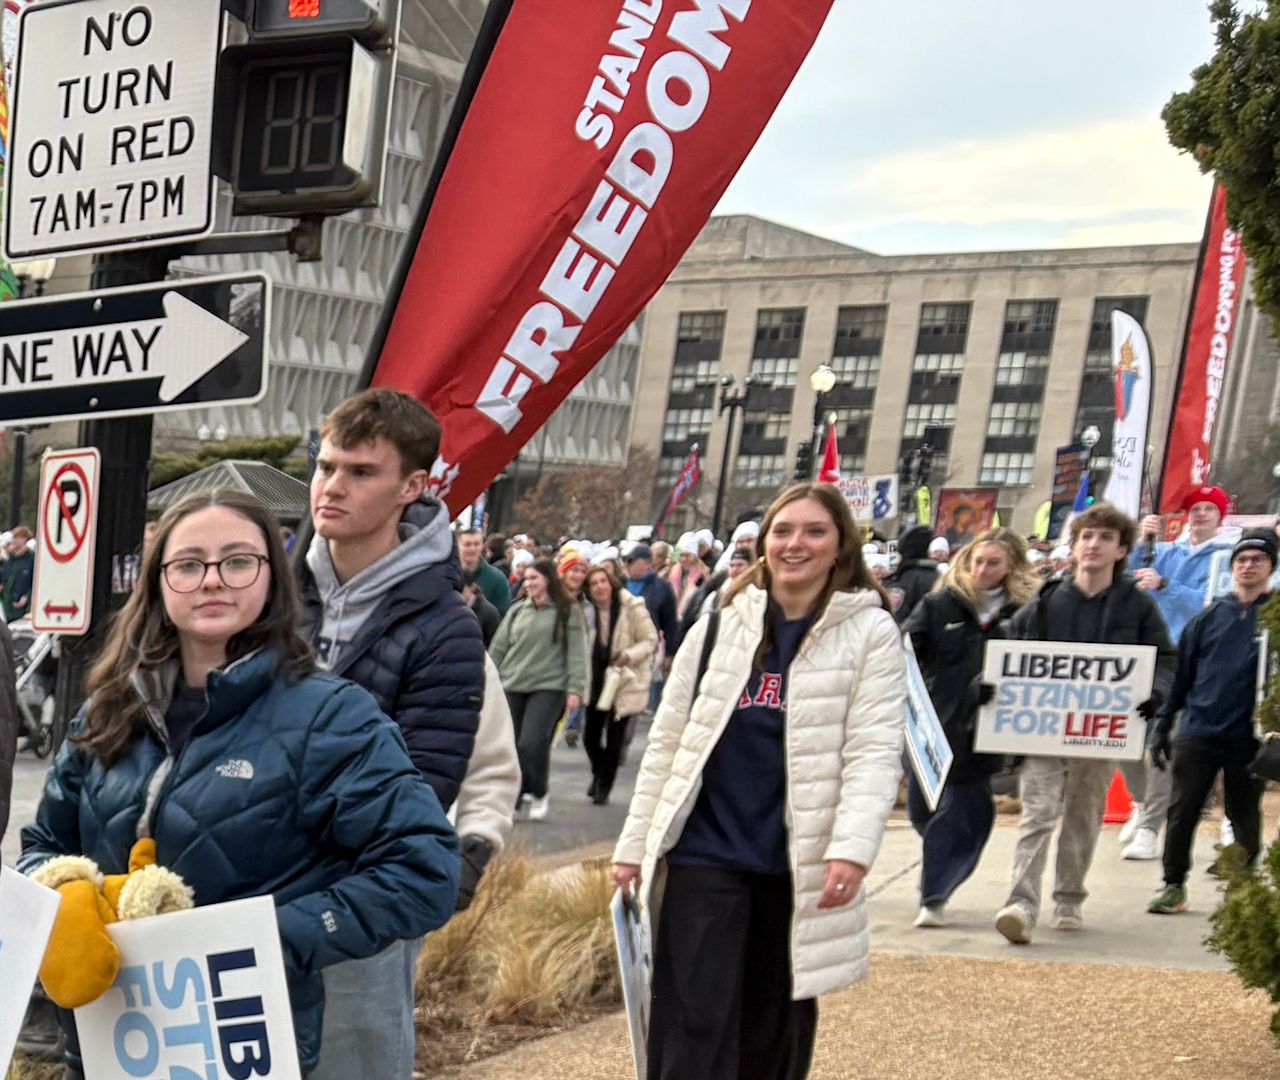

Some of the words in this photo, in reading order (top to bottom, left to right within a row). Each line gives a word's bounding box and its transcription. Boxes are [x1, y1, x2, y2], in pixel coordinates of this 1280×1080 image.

[83, 5, 153, 56] NO
[58, 61, 174, 119] TURN
[28, 133, 84, 179] ON
[111, 115, 195, 166] RED
[29, 174, 186, 237] 7AM-7PM
[476, 0, 752, 434] FREEDOM
[73, 325, 163, 379] WAY
[1001, 652, 1138, 682] LIBERTY
[994, 708, 1061, 736] FOR
[1064, 712, 1128, 739] LIFE
[996, 681, 1133, 712] STANDS
